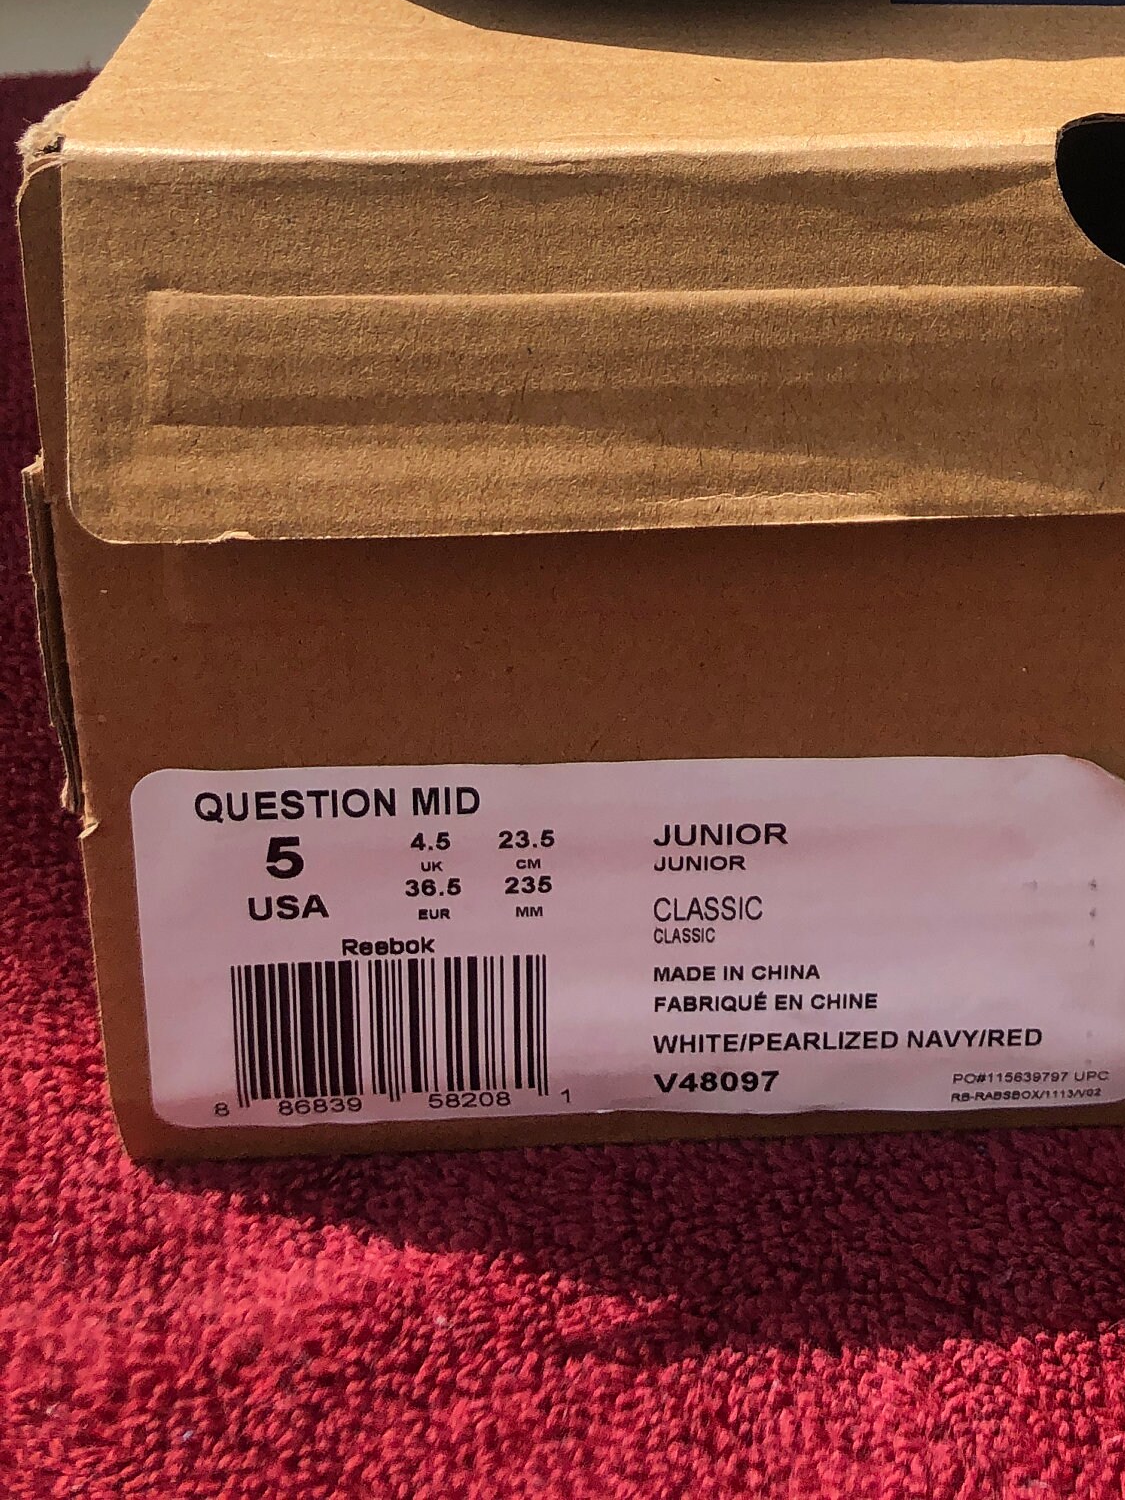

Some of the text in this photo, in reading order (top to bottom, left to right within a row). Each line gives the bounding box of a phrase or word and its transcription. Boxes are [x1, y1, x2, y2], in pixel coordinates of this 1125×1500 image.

[194, 786, 480, 822] QUESTION MID
[653, 823, 789, 847] JUNIOR
[265, 829, 555, 879] 5 4.5 23.5
[421, 858, 541, 872] UK CM
[653, 855, 746, 872] JUNIOR
[405, 875, 553, 898] 36.5 235
[248, 895, 544, 921] USA EUR MM
[653, 895, 763, 922] CLASSIC
[342, 937, 436, 956] Reebok
[653, 927, 716, 944] CLASSIC
[653, 964, 820, 982] MADE IN CHINA
[653, 991, 878, 1013] FABRIQUÉ EN CHINE
[653, 1028, 1043, 1054] WHITE/PEARLIZED NAVY/RED
[653, 1070, 780, 1093] V48097
[952, 1070, 1110, 1084] PO#115639797 UPC
[214, 1089, 572, 1118] 8 86839 58208 1
